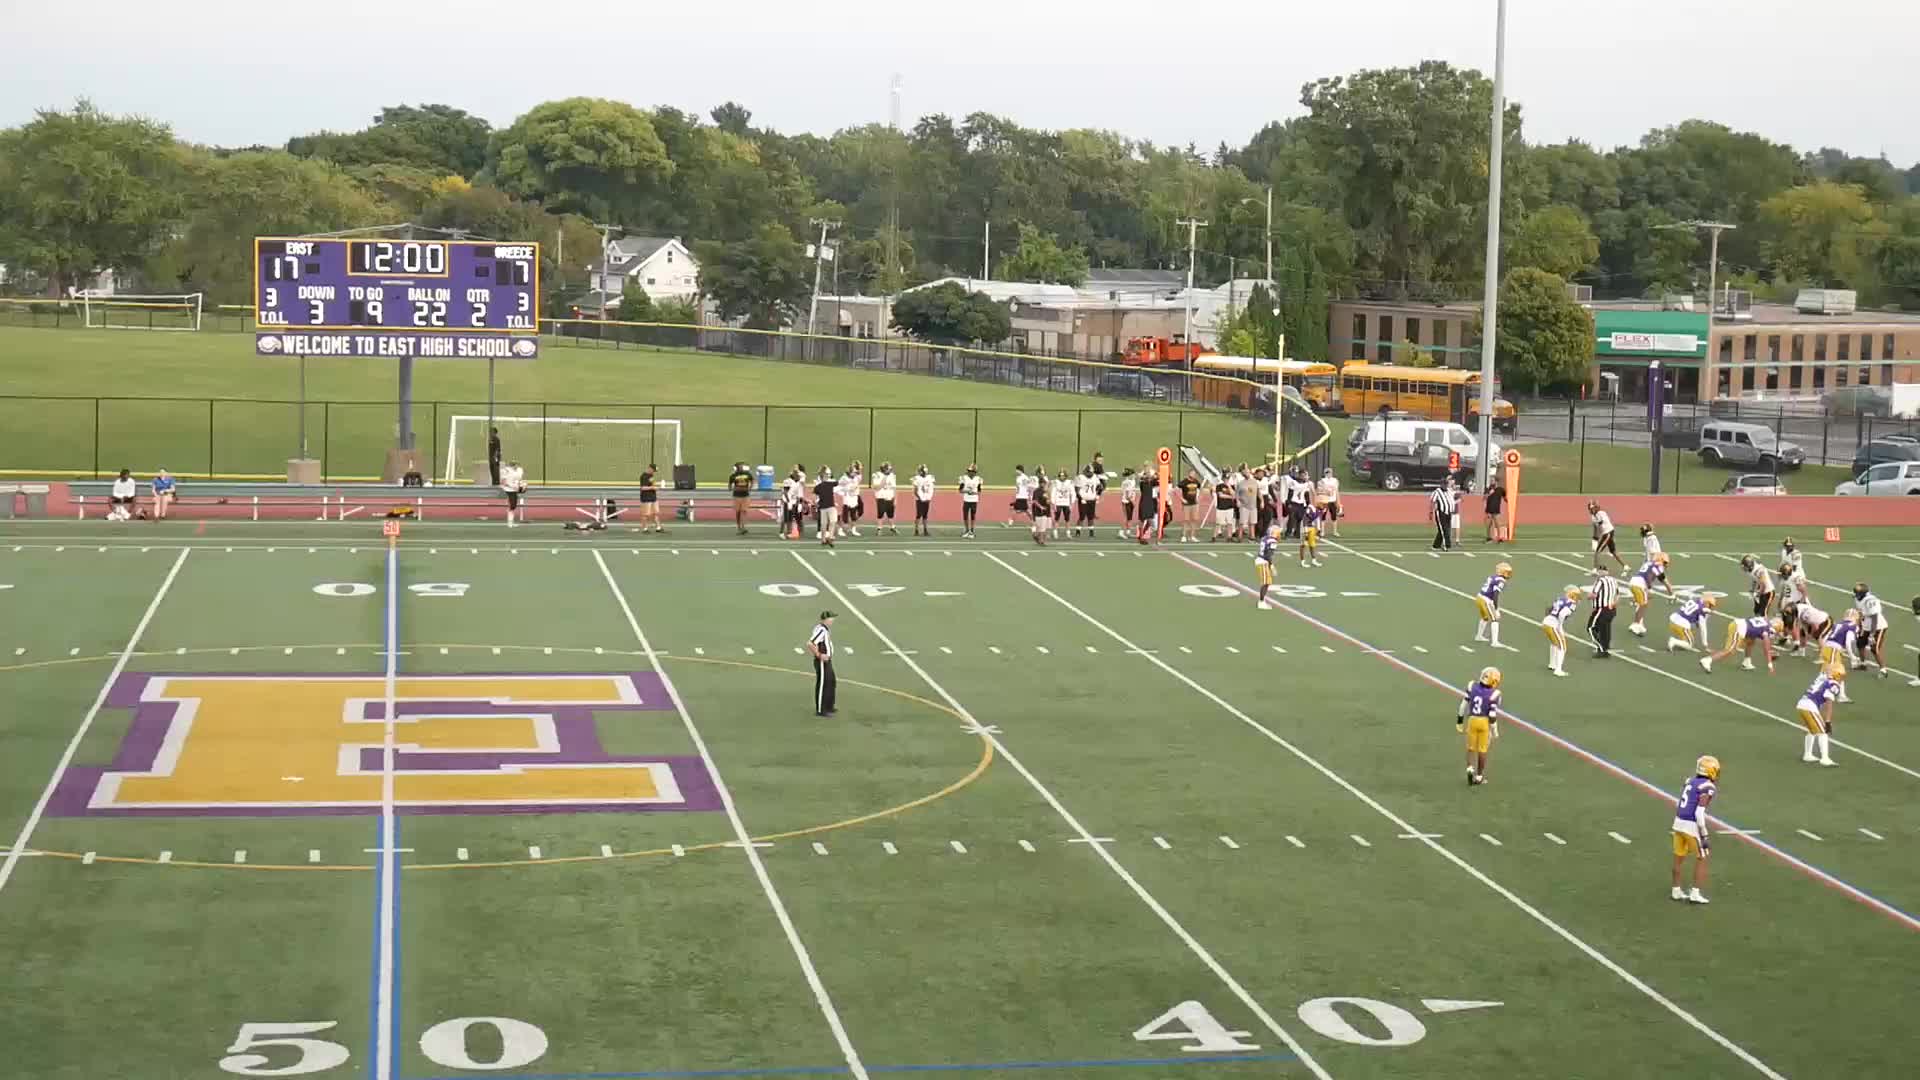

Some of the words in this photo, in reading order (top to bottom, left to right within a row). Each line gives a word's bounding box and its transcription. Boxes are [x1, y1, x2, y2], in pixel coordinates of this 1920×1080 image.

[285, 242, 314, 256] EAST
[364, 243, 444, 273] 12:00
[274, 256, 299, 279] 17
[515, 260, 529, 283] 7
[266, 287, 278, 307] 3
[298, 285, 335, 300] DOWN
[348, 286, 364, 300] TO
[366, 287, 383, 301] GO
[408, 288, 434, 302] BALL
[435, 288, 451, 302] ON
[466, 289, 490, 303] QTR
[518, 292, 529, 312] 3
[310, 299, 324, 324] 3
[367, 301, 383, 324] 9
[413, 302, 447, 326] 22
[471, 303, 487, 327] 2
[282, 335, 351, 355] WELCOME
[355, 336, 374, 355] TO
[379, 336, 416, 356] EAST
[420, 337, 454, 356] HIGH
[458, 338, 513, 357] SCHOOL
[1472, 695, 1483, 714] 3
[1680, 784, 1692, 808] 5
